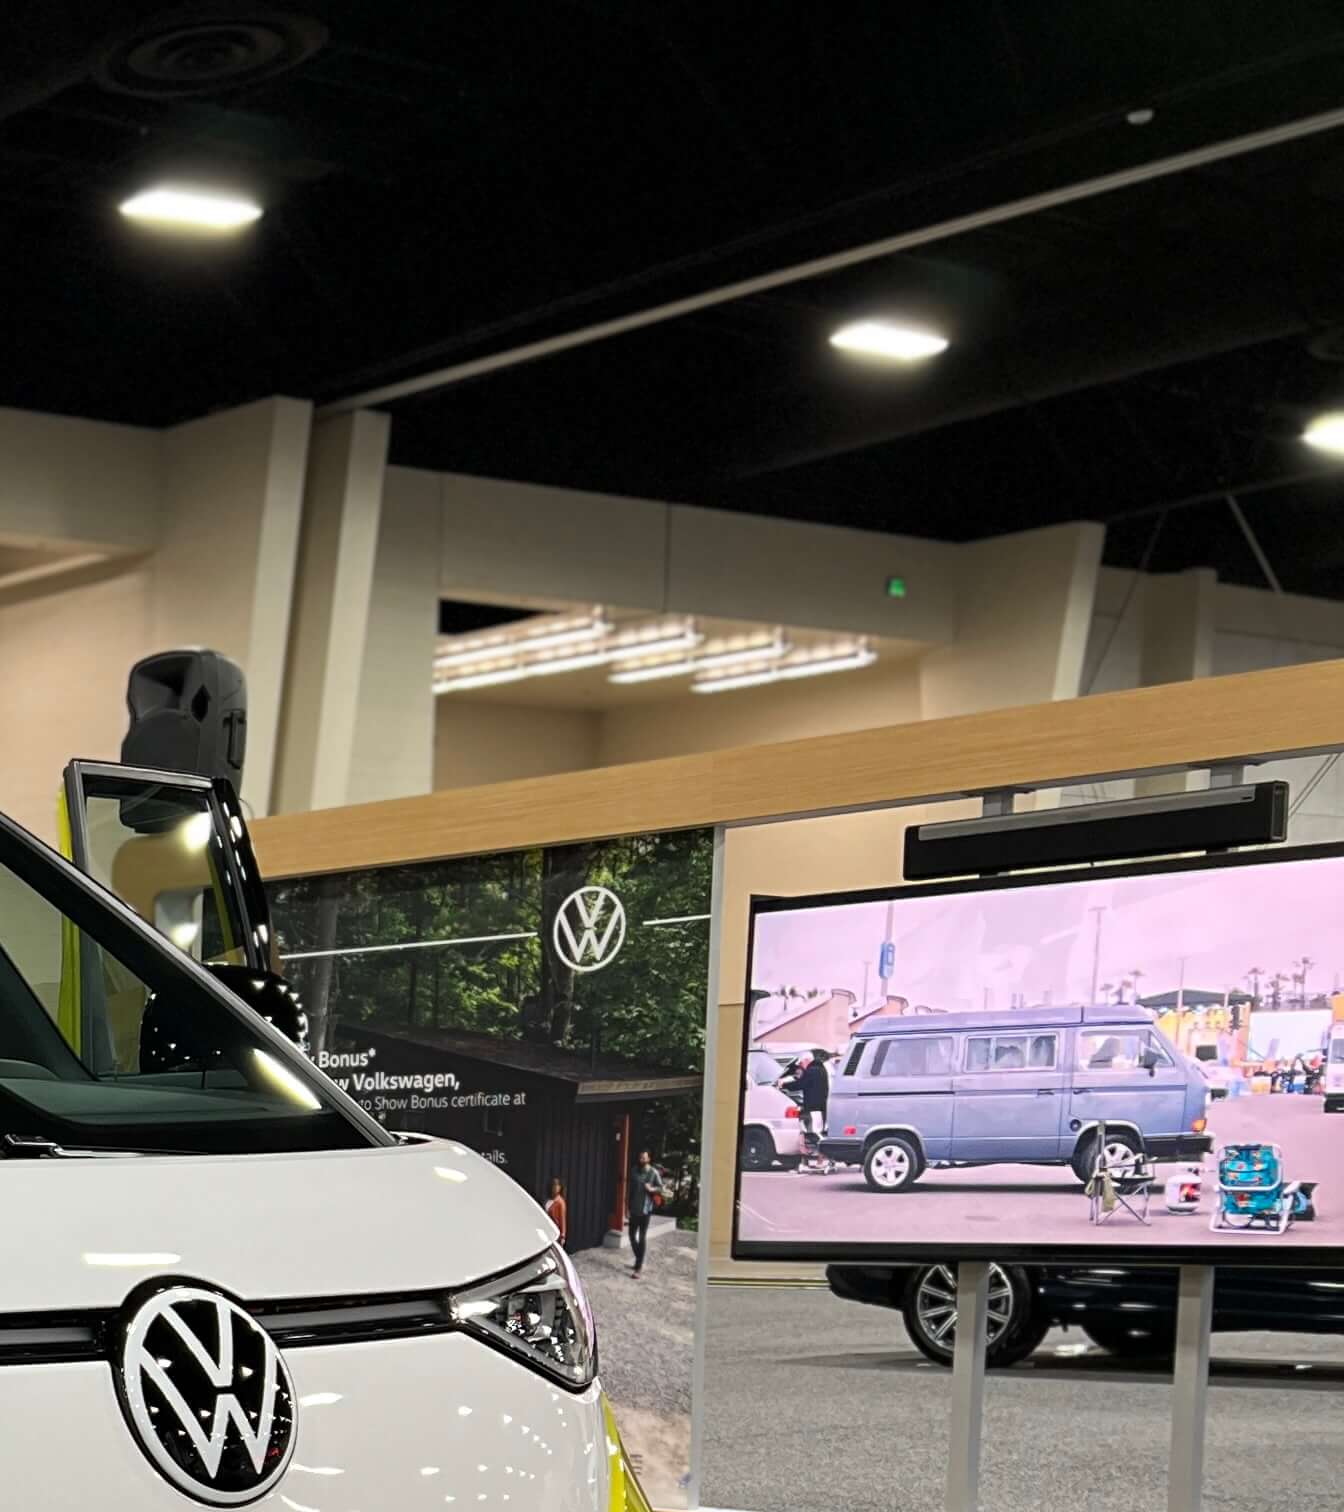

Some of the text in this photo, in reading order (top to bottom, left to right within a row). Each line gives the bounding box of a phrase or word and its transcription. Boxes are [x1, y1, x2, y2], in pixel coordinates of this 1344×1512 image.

[333, 1071, 461, 1093] w Volkswagen,
[374, 1096, 410, 1111] Show
[410, 1094, 449, 1110] Bonus
[451, 1091, 511, 1107] certificate
[512, 1091, 527, 1106] at
